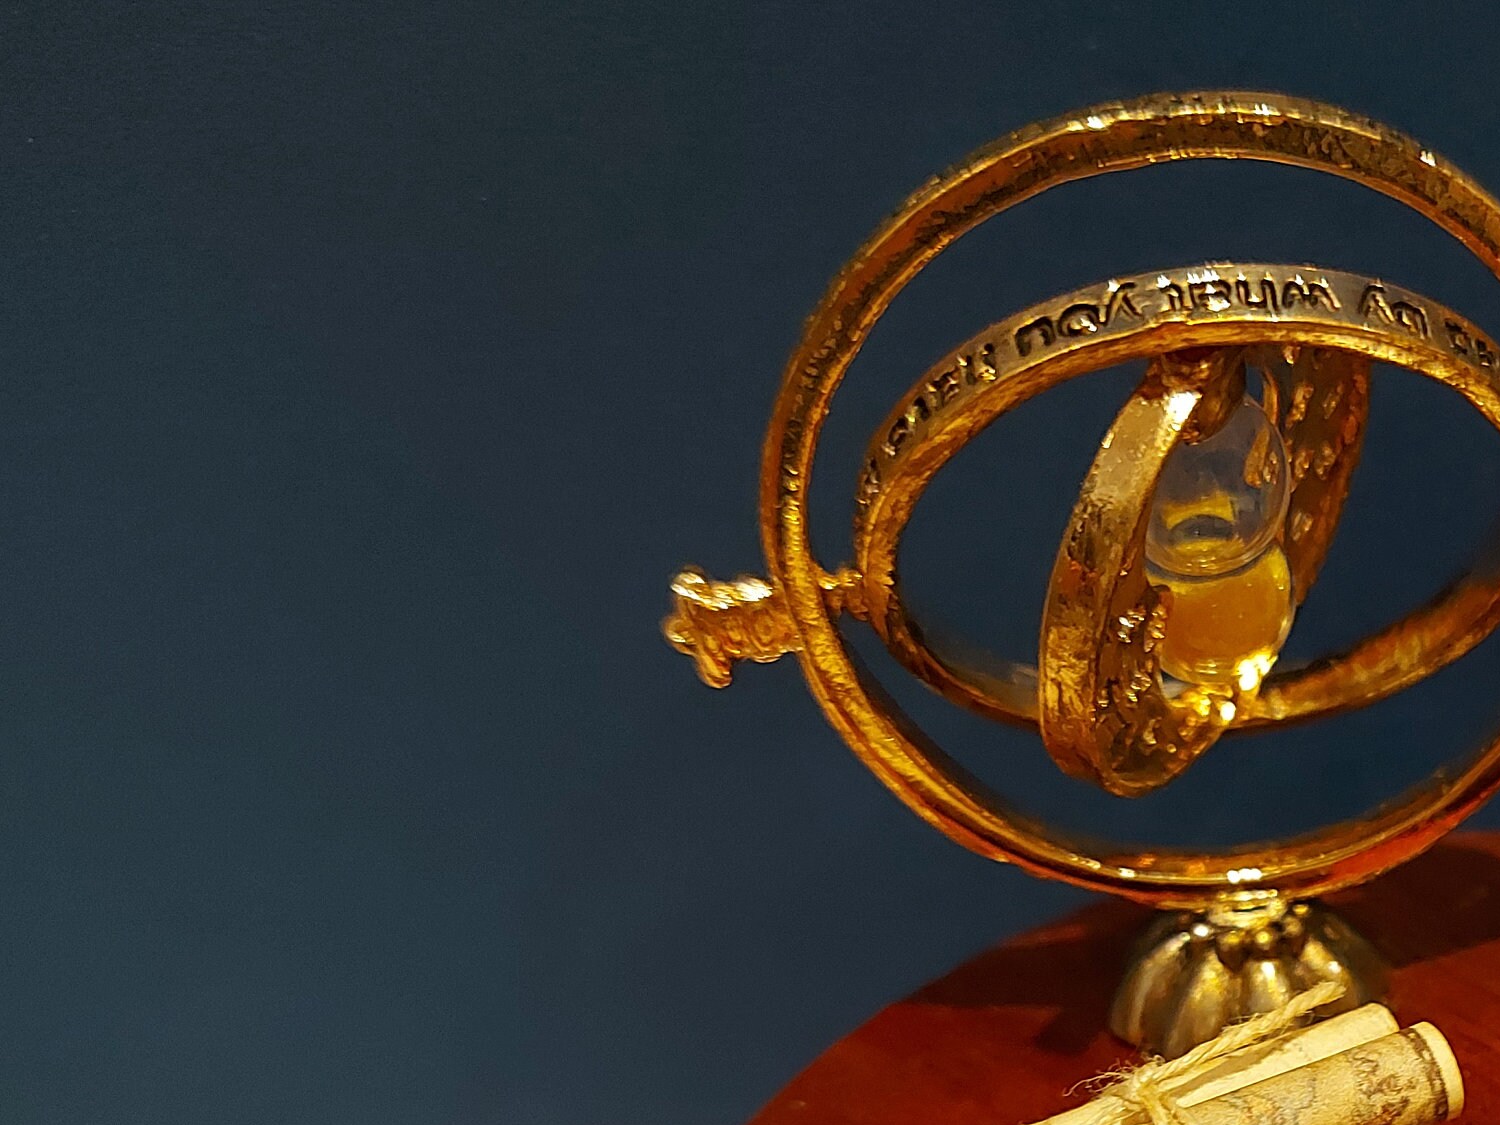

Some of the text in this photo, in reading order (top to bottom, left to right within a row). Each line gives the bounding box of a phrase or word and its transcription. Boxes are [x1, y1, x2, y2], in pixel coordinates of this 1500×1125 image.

[1015, 281, 1146, 357] you
[1159, 275, 1341, 322] what
[1357, 282, 1431, 340] by
